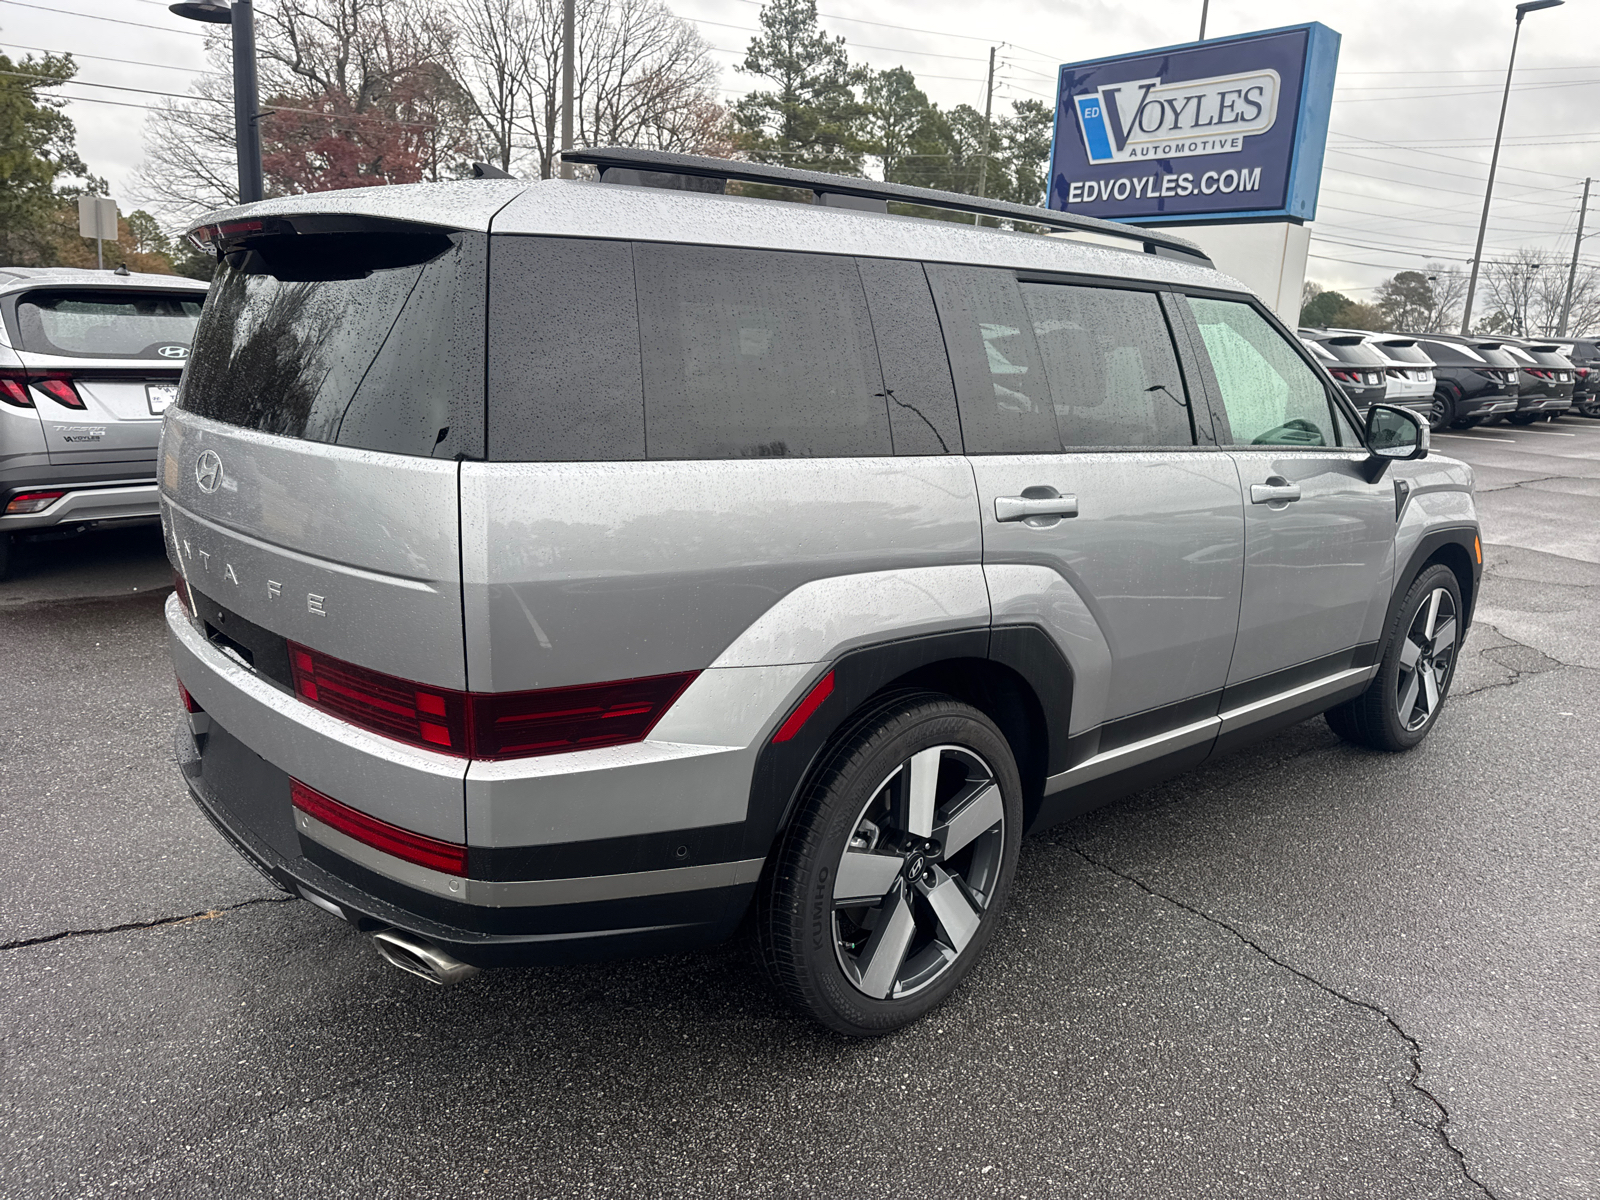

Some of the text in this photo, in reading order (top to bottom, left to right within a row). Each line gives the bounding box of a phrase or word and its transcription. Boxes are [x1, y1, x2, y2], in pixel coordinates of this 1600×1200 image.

[1084, 107, 1100, 119] ED
[1102, 82, 1264, 152] VOYLES
[1129, 137, 1240, 157] AUTOMOTIVE
[1068, 167, 1261, 203] EDVOYLES.COM
[267, 579, 327, 617] FE
[812, 866, 829, 950] KUMHO
